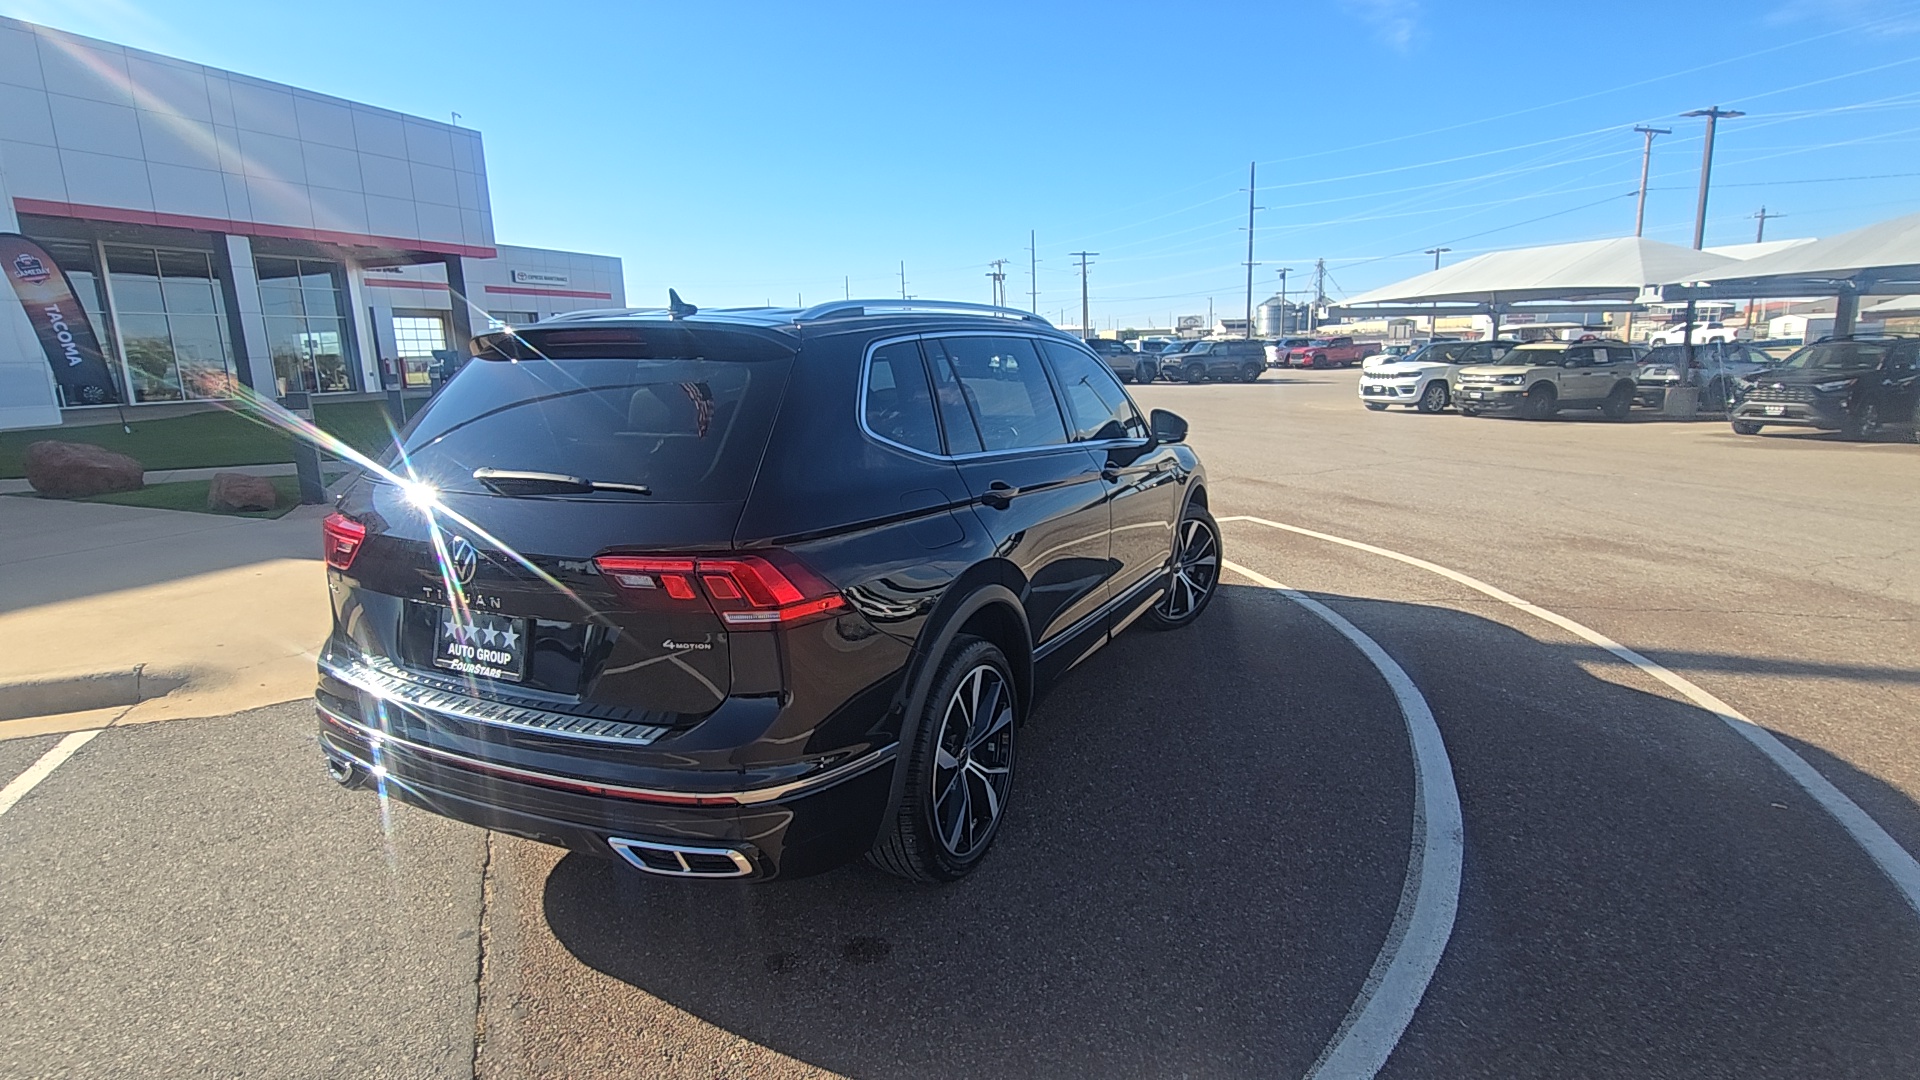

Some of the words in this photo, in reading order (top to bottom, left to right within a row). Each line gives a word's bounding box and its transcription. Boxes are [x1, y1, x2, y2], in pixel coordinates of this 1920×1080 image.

[14, 267, 50, 278] GAMEDAY
[45, 303, 82, 367] TACOMA
[447, 642, 475, 659] AUTO
[476, 648, 512, 665] GROUP
